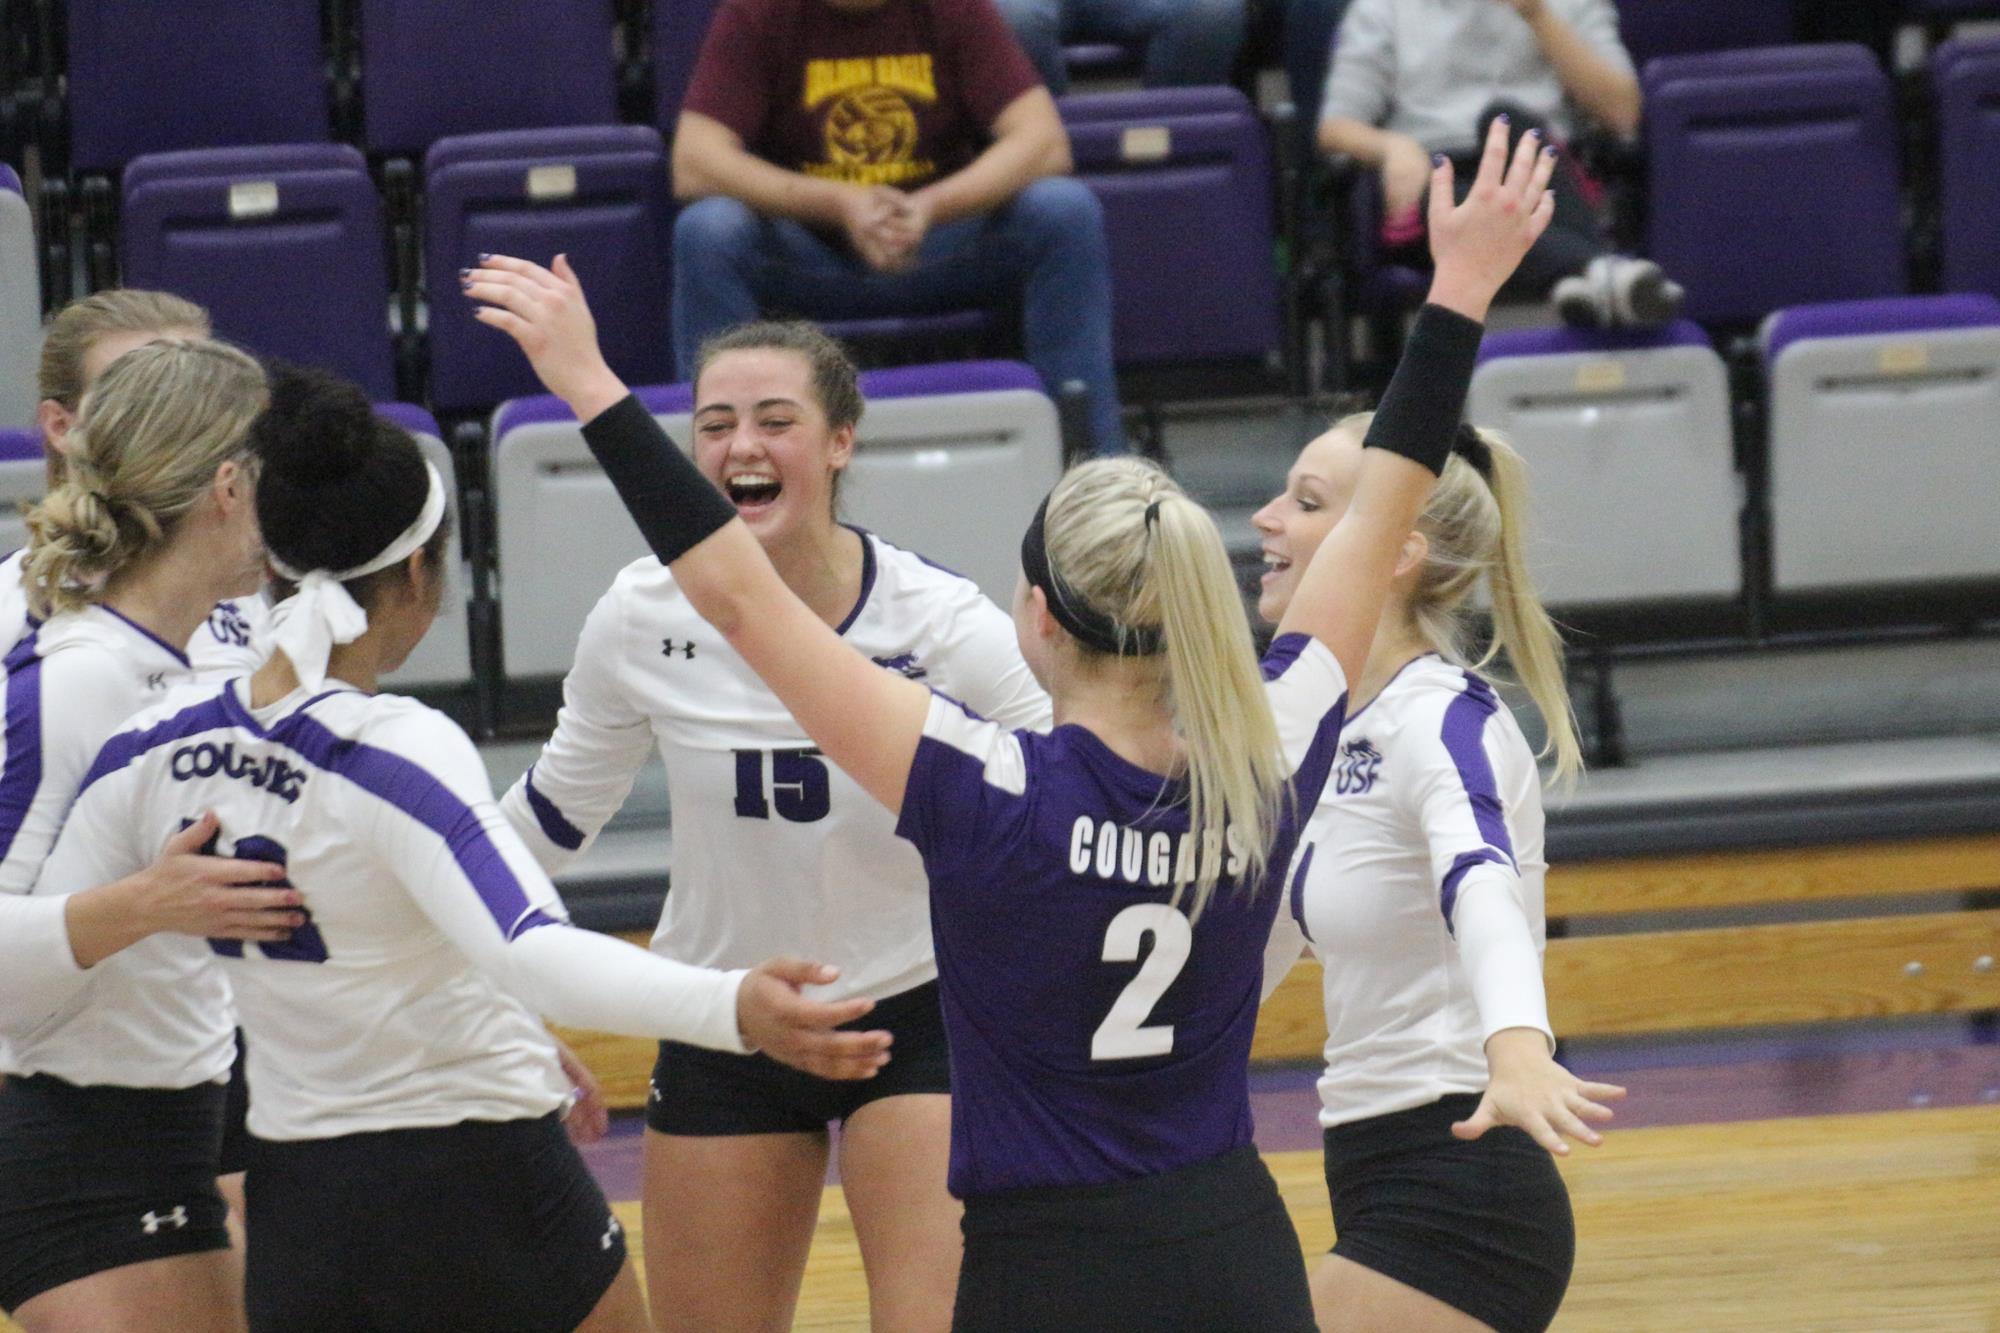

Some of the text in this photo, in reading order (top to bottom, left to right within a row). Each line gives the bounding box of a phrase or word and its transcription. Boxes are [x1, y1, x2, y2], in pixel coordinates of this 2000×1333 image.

[730, 747, 831, 823] 15
[1336, 757, 1383, 795] USF
[1091, 902, 1192, 1061] 2
